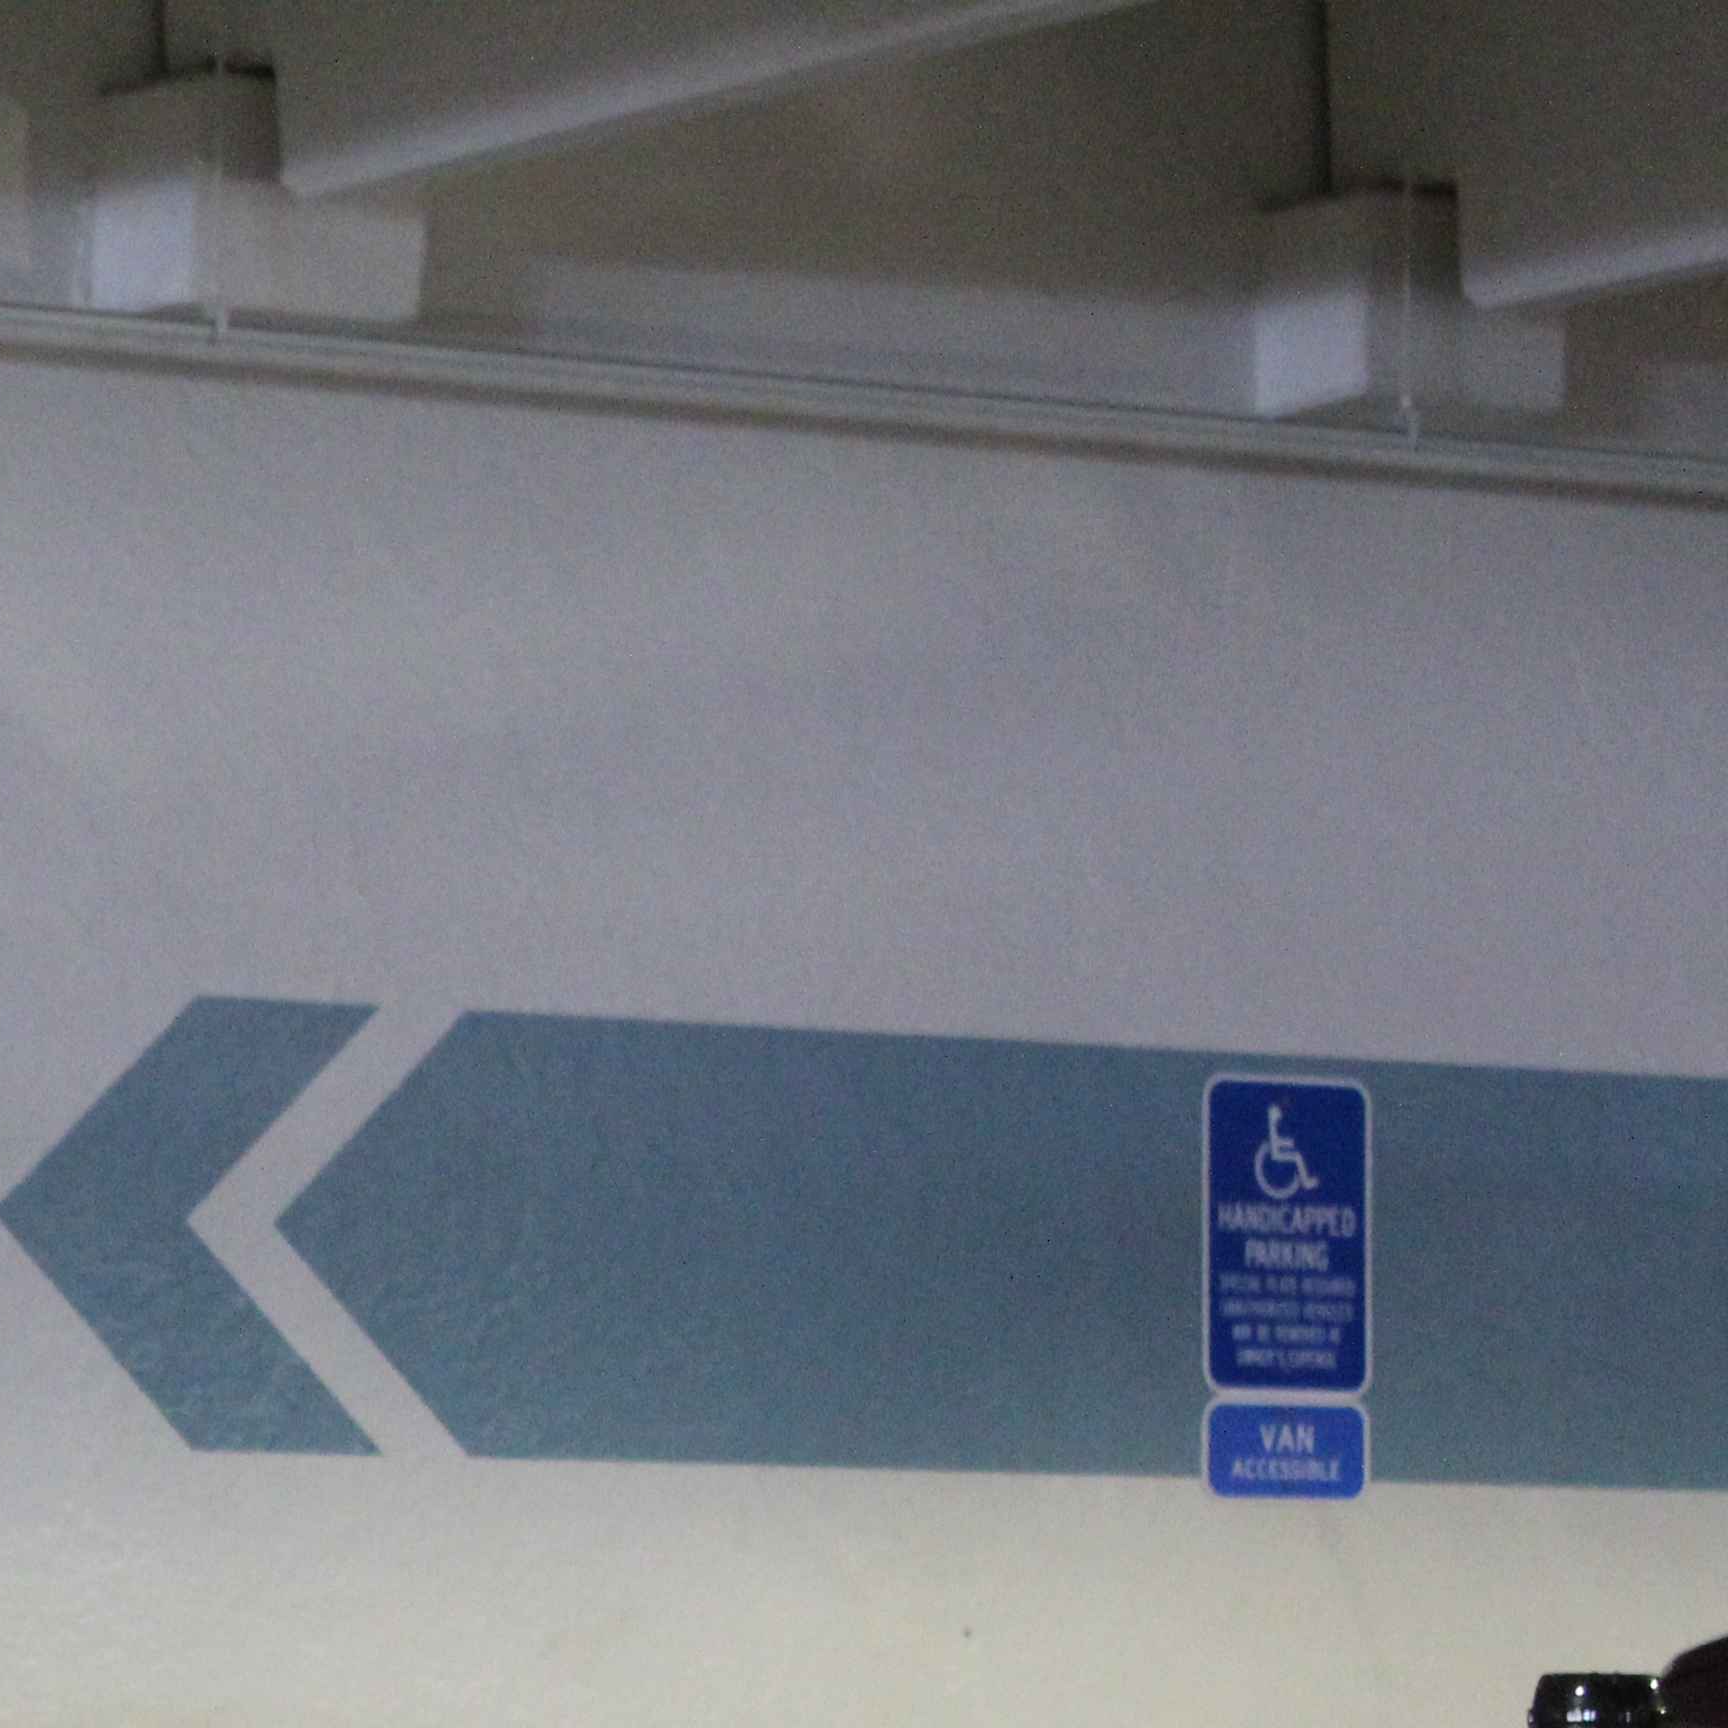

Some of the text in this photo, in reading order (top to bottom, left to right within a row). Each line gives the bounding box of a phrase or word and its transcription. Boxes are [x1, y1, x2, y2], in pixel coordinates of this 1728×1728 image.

[1218, 1203, 1357, 1238] HANDICAPPED
[1245, 1239, 1329, 1271] PARKING
[1259, 1424, 1315, 1453] VAN
[1231, 1457, 1341, 1482] ACCESSIBLE
